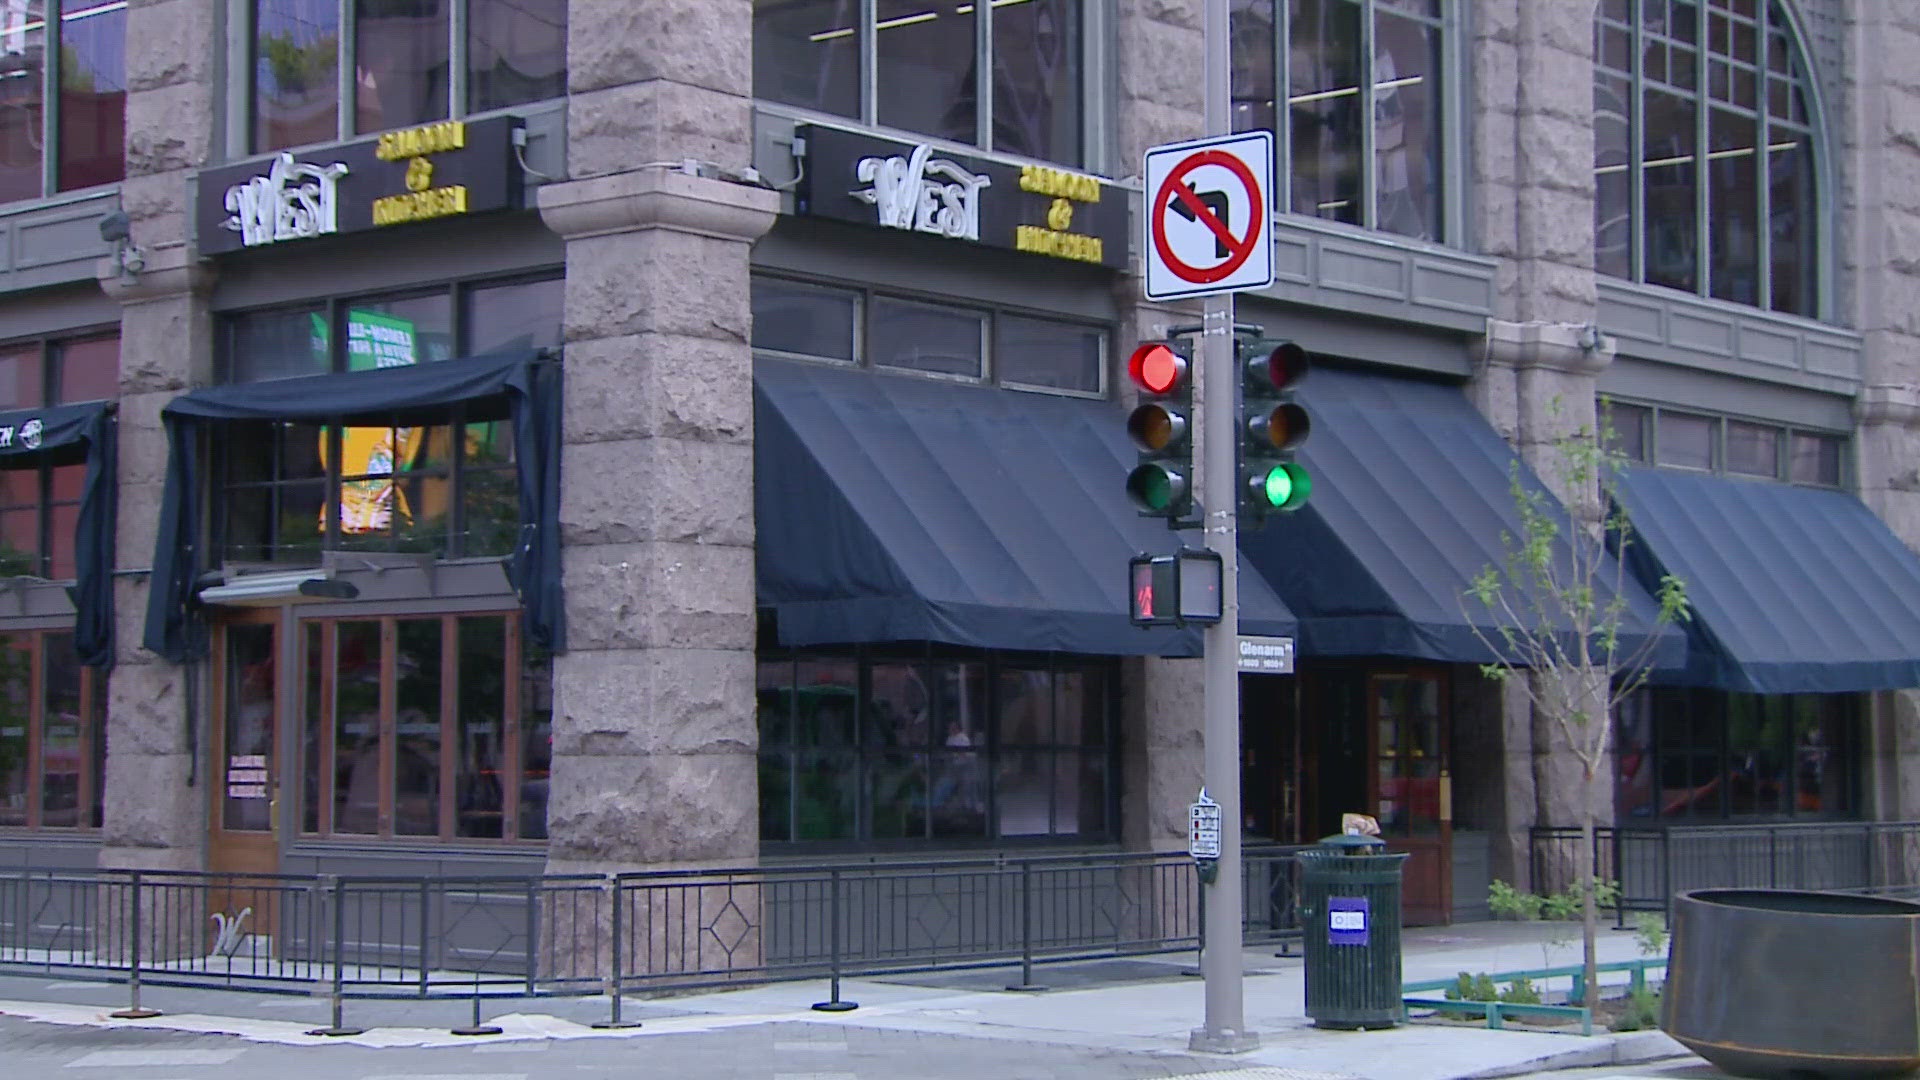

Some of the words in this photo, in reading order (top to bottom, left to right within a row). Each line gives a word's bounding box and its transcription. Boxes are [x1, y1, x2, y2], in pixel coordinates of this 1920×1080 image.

[405, 156, 433, 192] &
[1048, 198, 1073, 231] &
[1240, 641, 1285, 657] Glenarm
